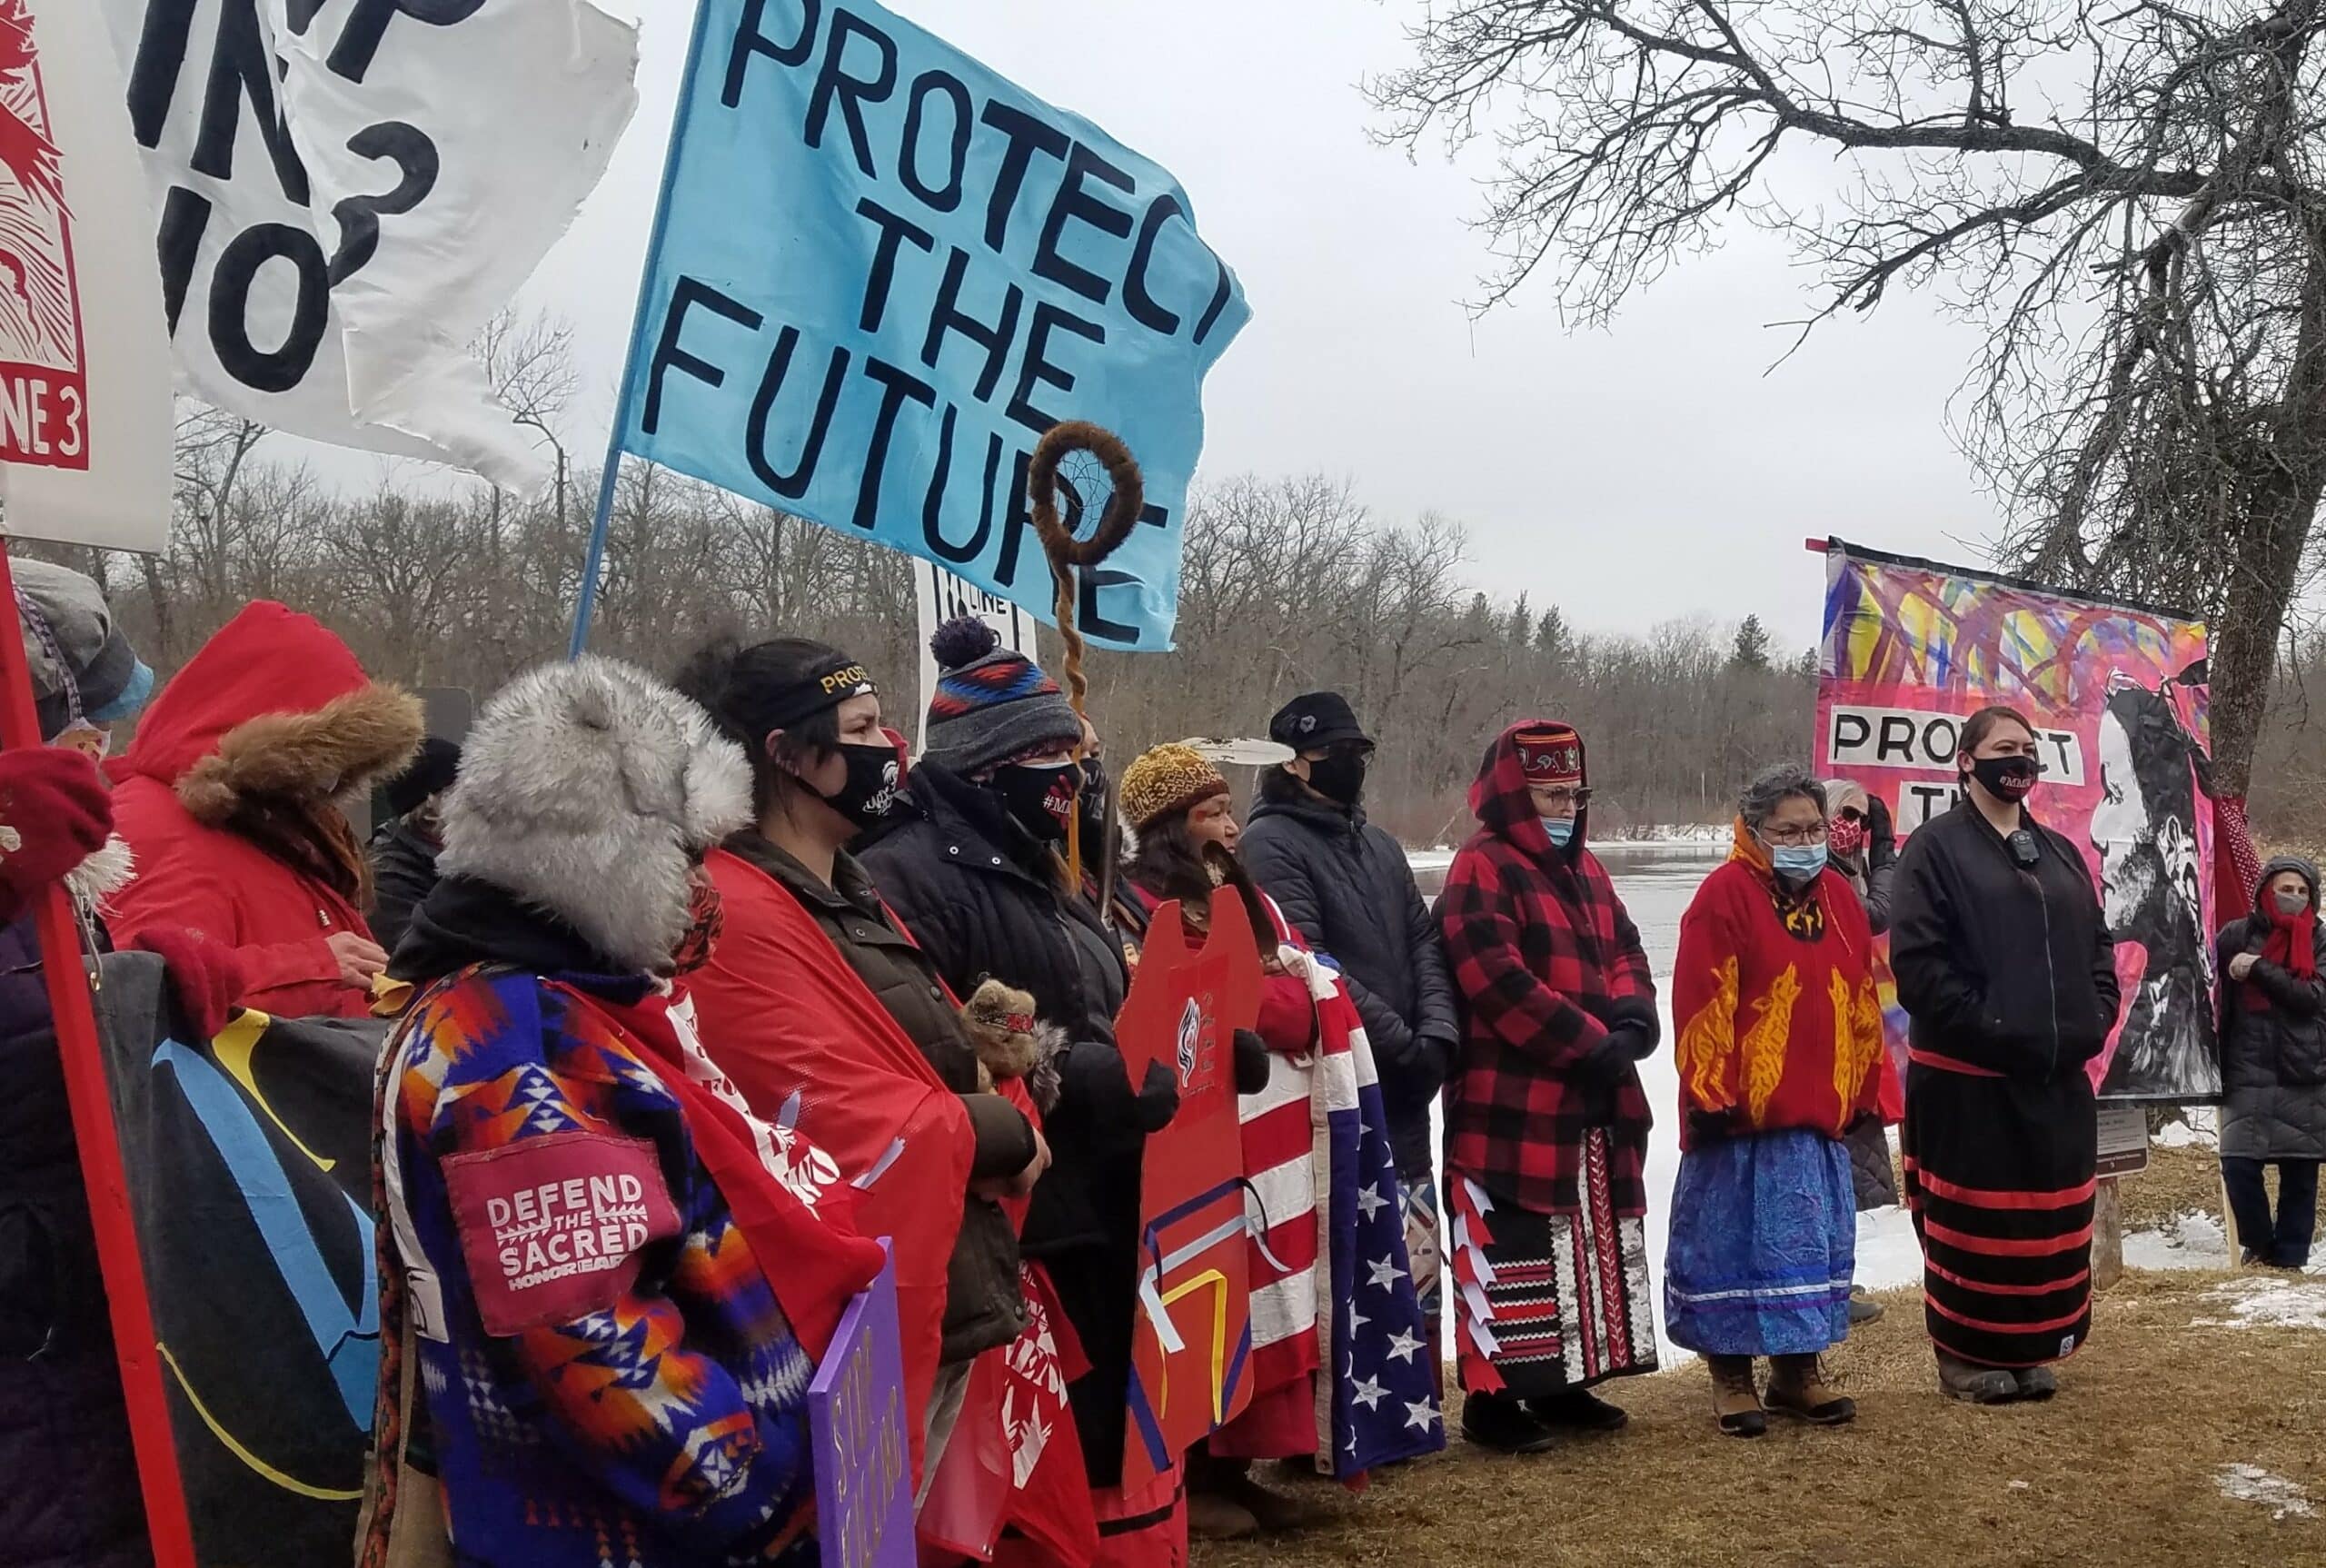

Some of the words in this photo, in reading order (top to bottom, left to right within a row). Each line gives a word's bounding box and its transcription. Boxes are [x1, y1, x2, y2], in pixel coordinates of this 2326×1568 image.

[855, 196, 1107, 434] THE
[58, 385, 82, 456] 3
[486, 1174, 642, 1228] DEFEND
[554, 1210, 591, 1231] THE
[499, 1223, 649, 1277] SACRED
[508, 1262, 579, 1292] HONOR
